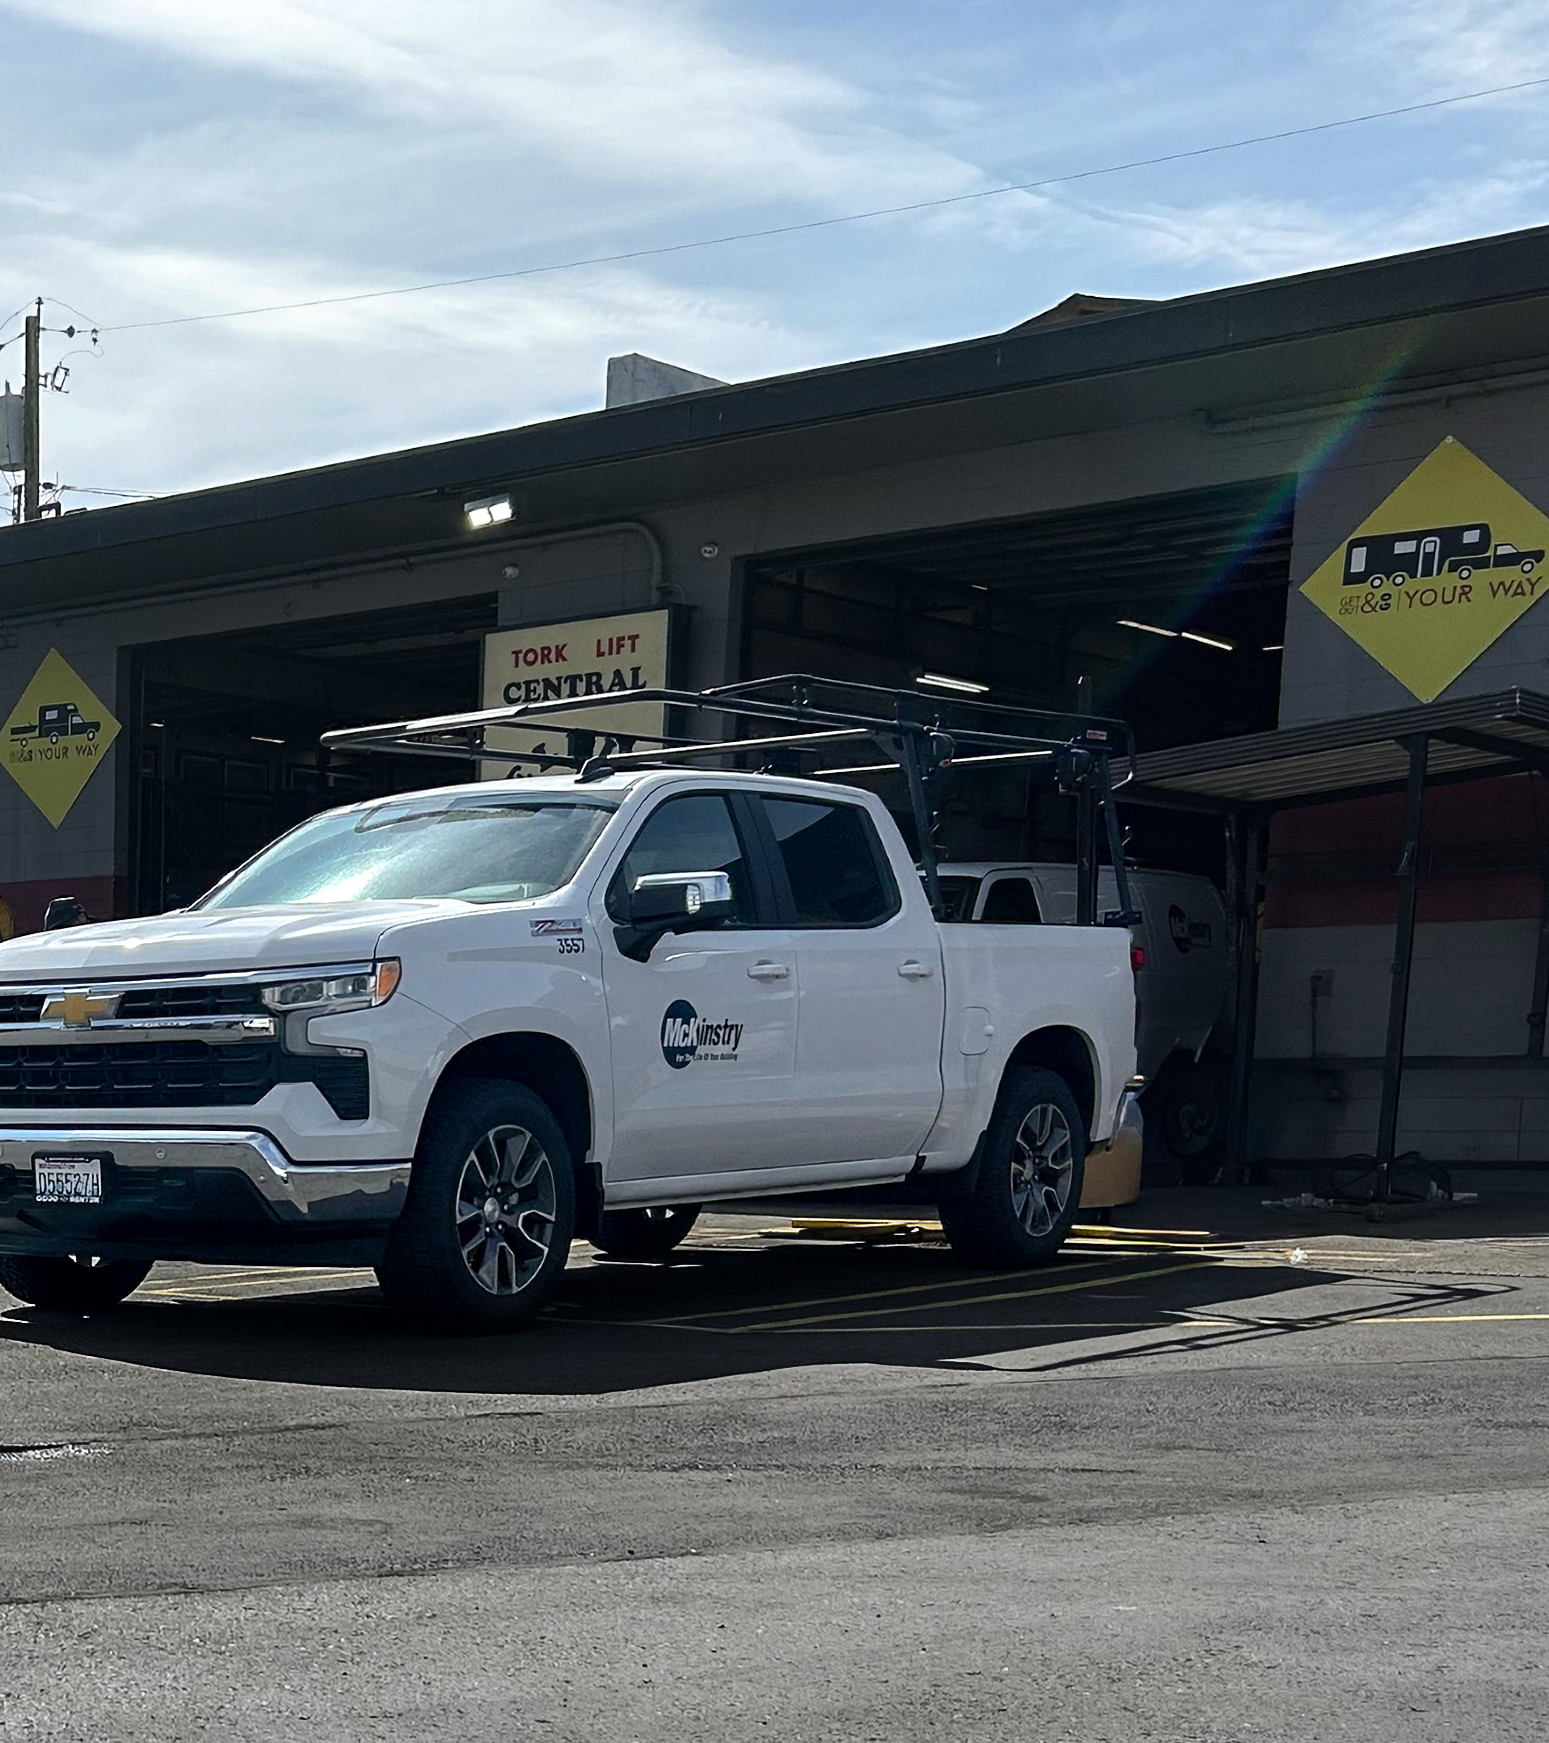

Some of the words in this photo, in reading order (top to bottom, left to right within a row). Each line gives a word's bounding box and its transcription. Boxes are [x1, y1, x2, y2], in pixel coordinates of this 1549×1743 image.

[1404, 584, 1473, 609] YOUR
[1489, 576, 1543, 599] WAY
[511, 643, 568, 668] TORK
[596, 634, 640, 658] LIFT
[503, 666, 647, 704] CENTRAL
[37, 746, 69, 761] YOUR
[76, 744, 100, 757] WAY
[556, 938, 585, 954] 3557
[663, 1018, 743, 1052] McKinstry
